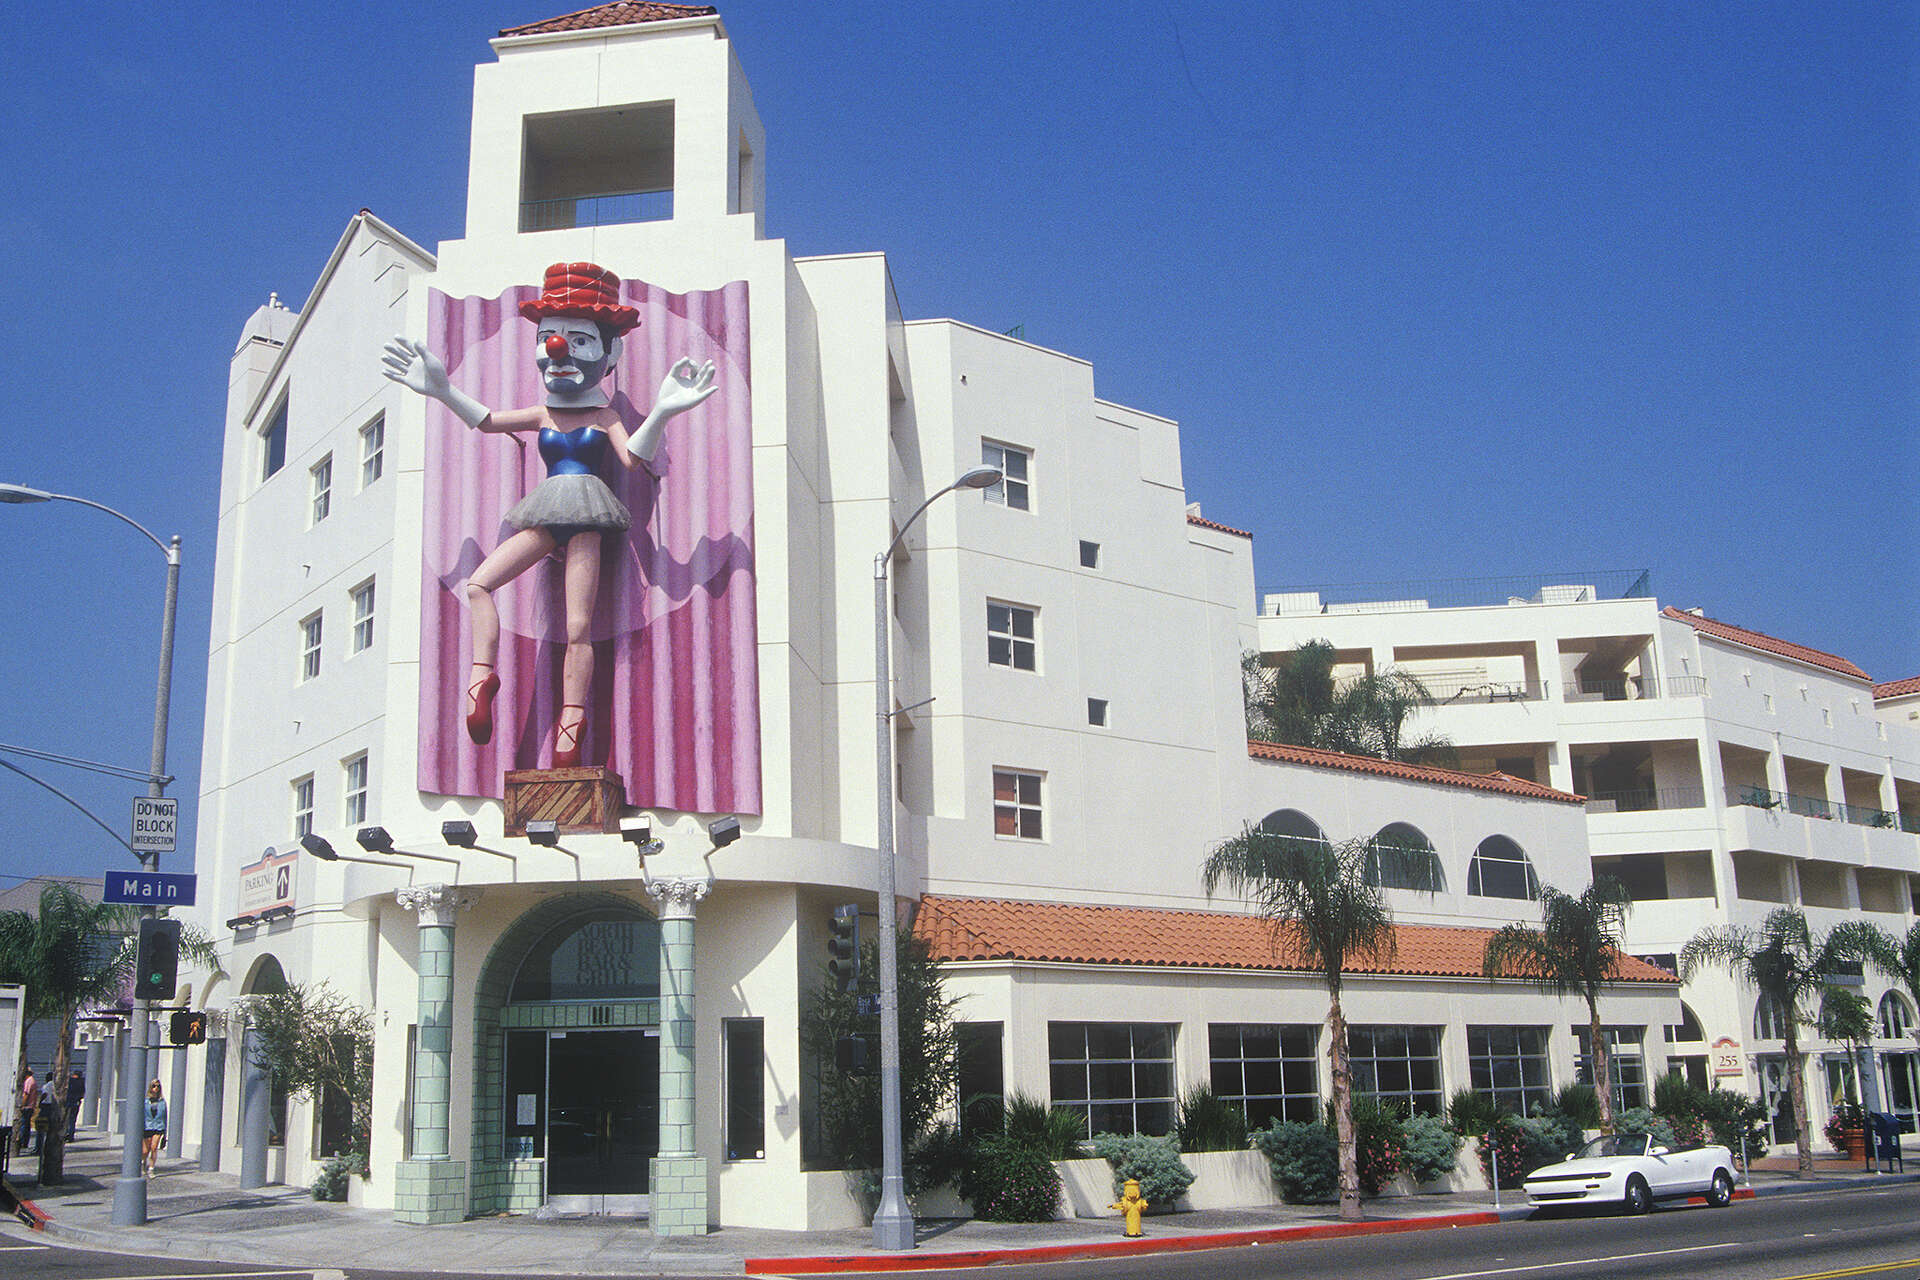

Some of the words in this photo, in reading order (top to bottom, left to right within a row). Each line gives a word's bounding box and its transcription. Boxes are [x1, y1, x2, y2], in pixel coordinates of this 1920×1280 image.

[137, 803, 152, 815] DO
[154, 804, 175, 816] NOT
[136, 820, 173, 832] BLOCK
[134, 835, 174, 845] INTERSECTION
[123, 879, 177, 897] Main
[245, 872, 274, 891] PARKING
[579, 922, 633, 939] NORTH
[578, 954, 615, 970] BAR
[577, 969, 635, 985] GRILL
[1720, 1055, 1738, 1067] 255
